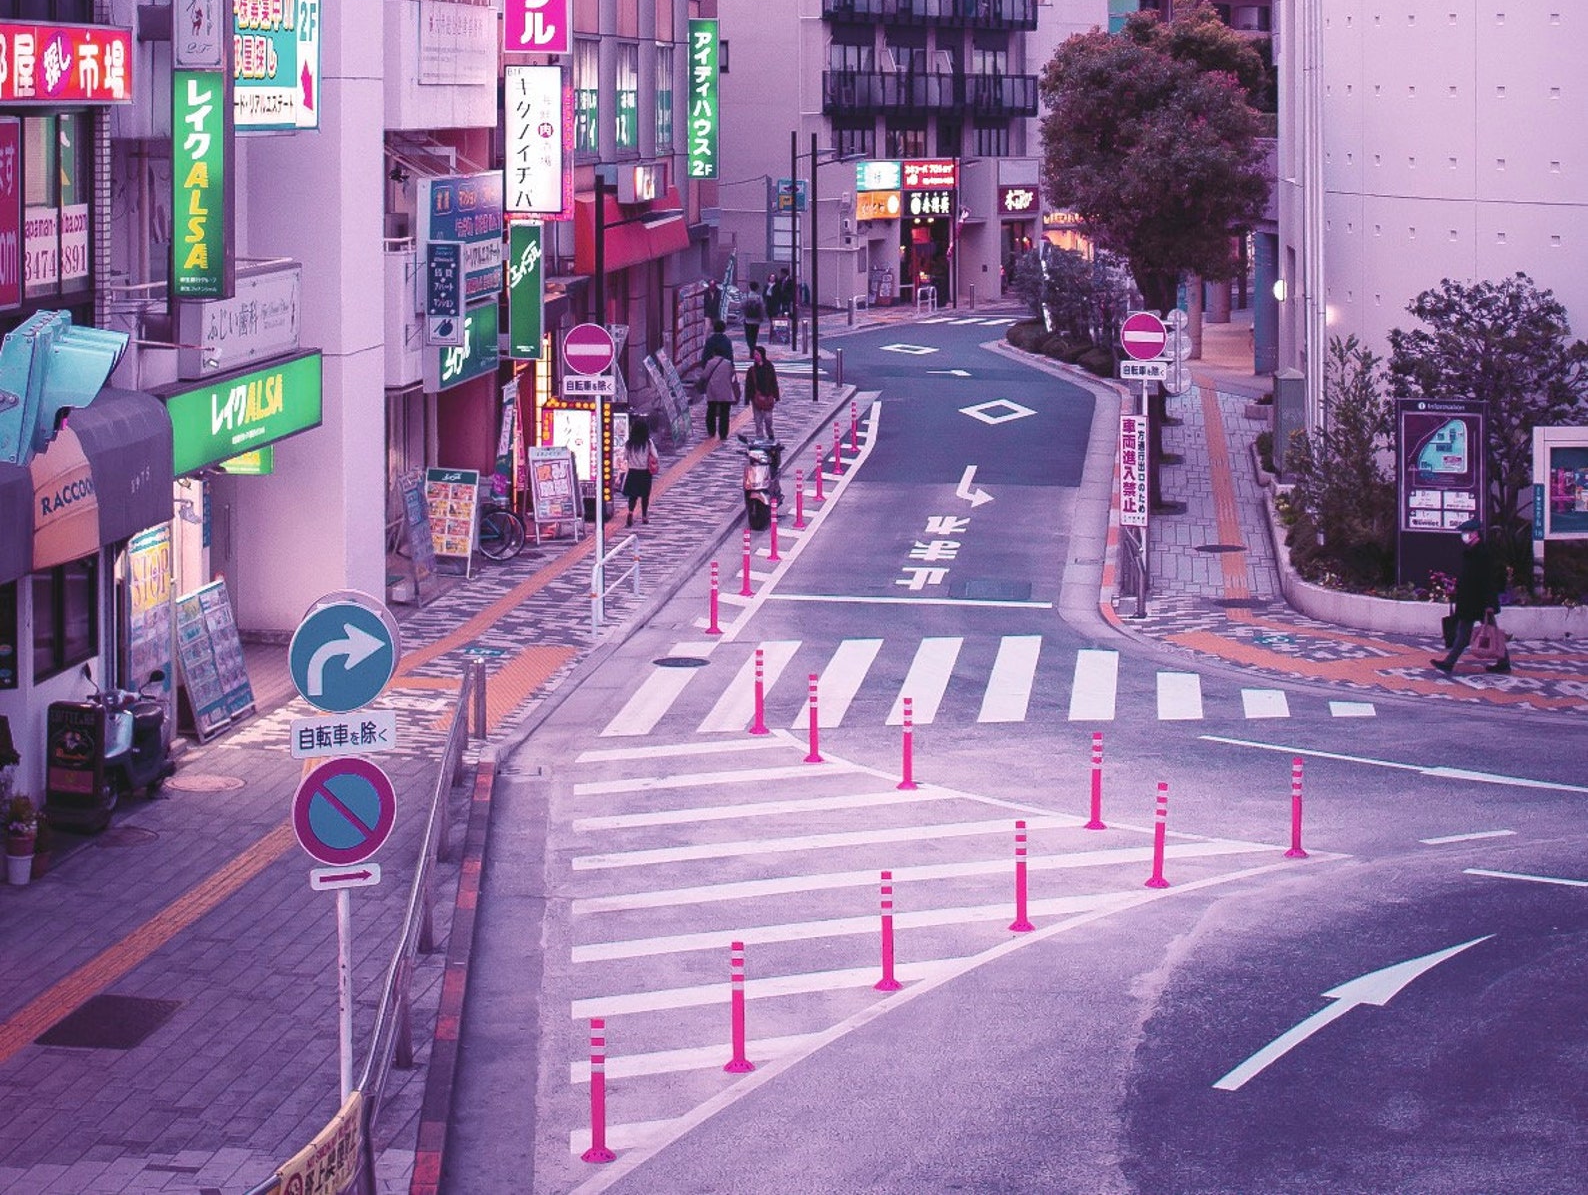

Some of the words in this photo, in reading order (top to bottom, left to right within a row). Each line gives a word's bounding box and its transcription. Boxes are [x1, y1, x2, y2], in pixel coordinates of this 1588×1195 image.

[300, 1, 317, 42] 2F
[692, 31, 713, 156] アイティハウス
[515, 77, 533, 208] キクノイチバ
[691, 159, 713, 177] 2F
[61, 244, 87, 275] 891
[207, 300, 258, 341] ふじい歯科
[566, 380, 612, 392] 自転車を除く
[1122, 419, 1137, 514] 車両進入禁止
[300, 720, 388, 751] 自転車を除く
